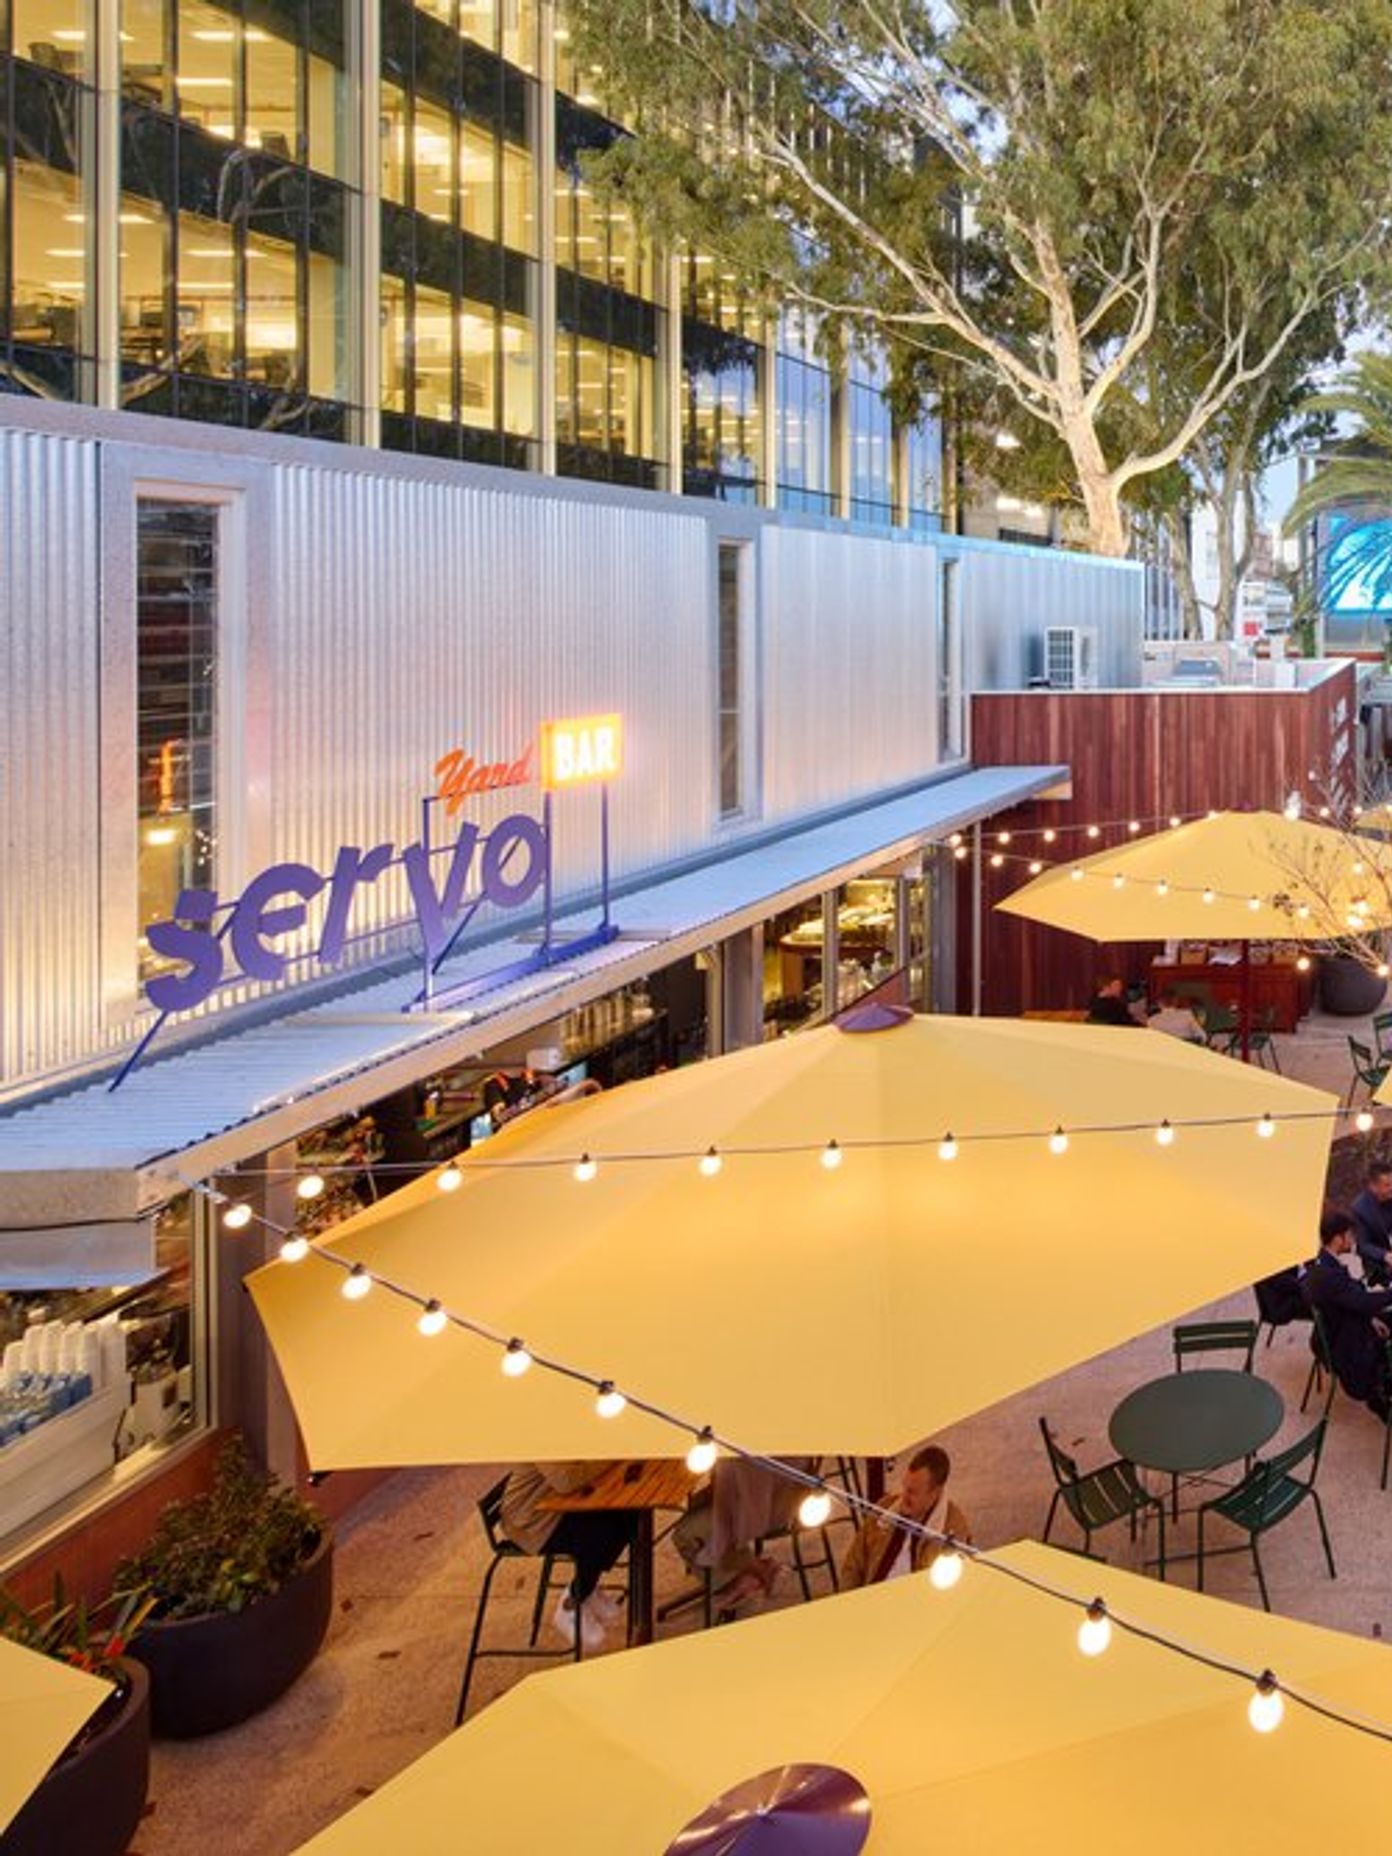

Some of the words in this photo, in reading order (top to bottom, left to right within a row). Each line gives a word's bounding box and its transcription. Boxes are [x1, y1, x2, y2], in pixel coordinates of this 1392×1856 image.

[434, 743, 534, 816] Yard
[553, 726, 615, 780] BAR
[145, 814, 547, 1011] servo
